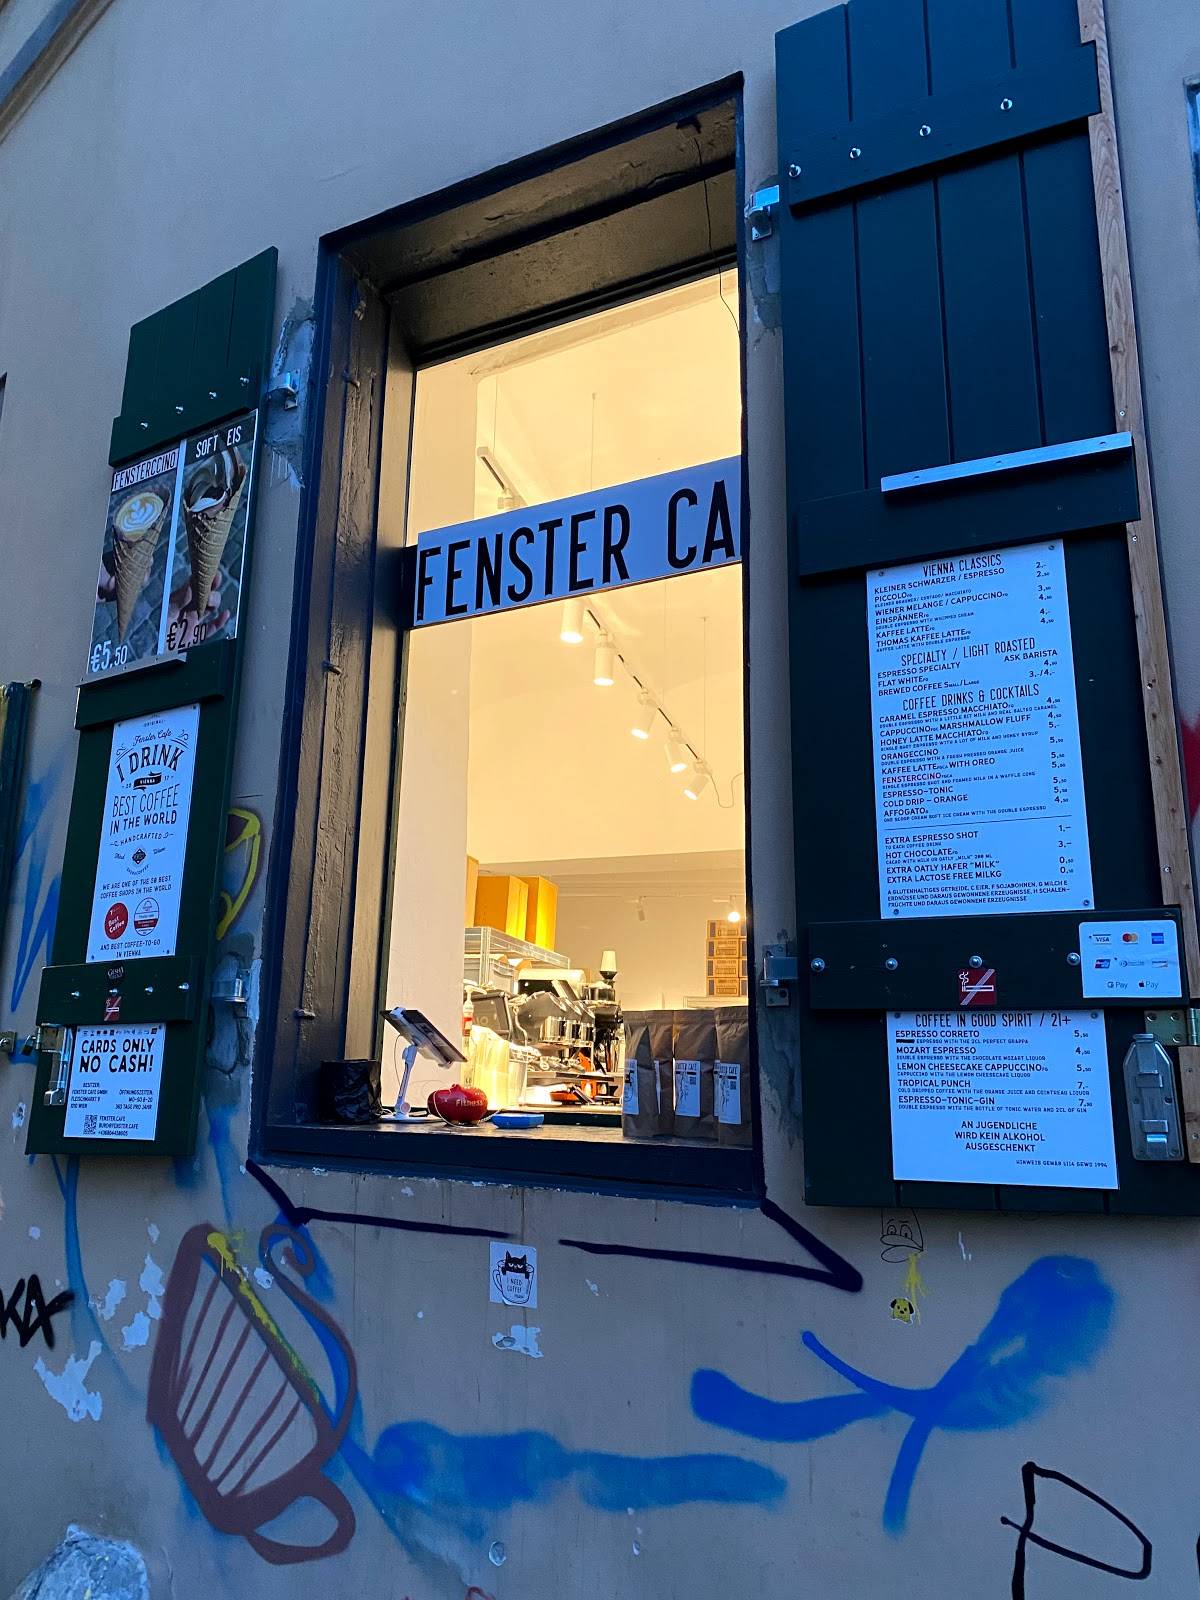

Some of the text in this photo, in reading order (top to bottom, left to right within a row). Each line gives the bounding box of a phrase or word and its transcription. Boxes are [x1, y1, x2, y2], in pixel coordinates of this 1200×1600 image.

[196, 426, 242, 458] SOFT EIS
[112, 451, 177, 491] FENSTERCCINO
[416, 480, 736, 621] FENSTER CA
[922, 553, 1002, 577] VIENNA CLASSICS
[874, 567, 1004, 594] KLEINER SCHWARZER ESPRESSO
[874, 605, 904, 616] WIENER
[906, 599, 943, 611] MELANGE
[876, 628, 904, 638] KAFFEE
[876, 636, 908, 647] THOMAS
[910, 632, 939, 642] KAFFEE
[901, 637, 1035, 666] SPECIALTY LIGHT ROASTED
[877, 648, 1057, 678] ESPRESSO SPECIALTY ASK BARISTA
[877, 679, 895, 687] FLAT
[878, 682, 942, 696] BREWED COFFEE
[902, 683, 1039, 711] COFFEE DRINKS & COCKTAILS
[879, 712, 916, 723] CARAMEL
[918, 707, 958, 718] ESPRESSO
[939, 717, 1003, 730] MARSHMALLOW
[1005, 714, 1031, 723] FLUFF
[880, 737, 907, 746] HONEY
[909, 734, 933, 743] LATTE
[128, 743, 185, 772] DRINK
[881, 748, 938, 760] ORANGECCINO
[881, 765, 911, 775] KAFFEE
[948, 759, 970, 768] WITH
[972, 757, 995, 766] OREO
[883, 785, 953, 798] ESPRESSO-TONIC
[112, 784, 180, 818] BEST COFFEE
[883, 793, 968, 807] COLD DRIP ORANGE
[110, 809, 177, 836] IN THE WORLD
[119, 833, 162, 847] HANDCRAFTED
[885, 830, 978, 844] EXTRA ESPRESSO SHOT
[885, 851, 901, 859] HOT
[886, 866, 912, 874] EXTRA
[914, 864, 938, 872] OATLY
[940, 862, 967, 870] HAFER
[887, 869, 1001, 884] EXTRA LACTOSE FREE MILKG
[1145, 980, 1159, 990] Pay
[915, 1014, 951, 1028] COFFEE
[956, 1014, 965, 1027] IN
[971, 1013, 996, 1027] GOOD
[1001, 1013, 1032, 1026] SPIRIT
[1050, 1012, 1071, 1027] 21+
[80, 1037, 154, 1053] CARDS ONLY
[78, 1054, 153, 1072] NO CASH!
[897, 1079, 939, 1087] TROPICAL
[455, 1099, 484, 1107] Fitness
[898, 1095, 994, 1104] ESPRESSO-TONIC-GIN
[975, 1121, 1037, 1129] JUGENDLICHE
[954, 1131, 977, 1139] WIRD
[1002, 1132, 1045, 1141] ALKOHOL
[965, 1142, 1035, 1152] AUSGESCHENKT
[510, 1278, 523, 1286] NEED
